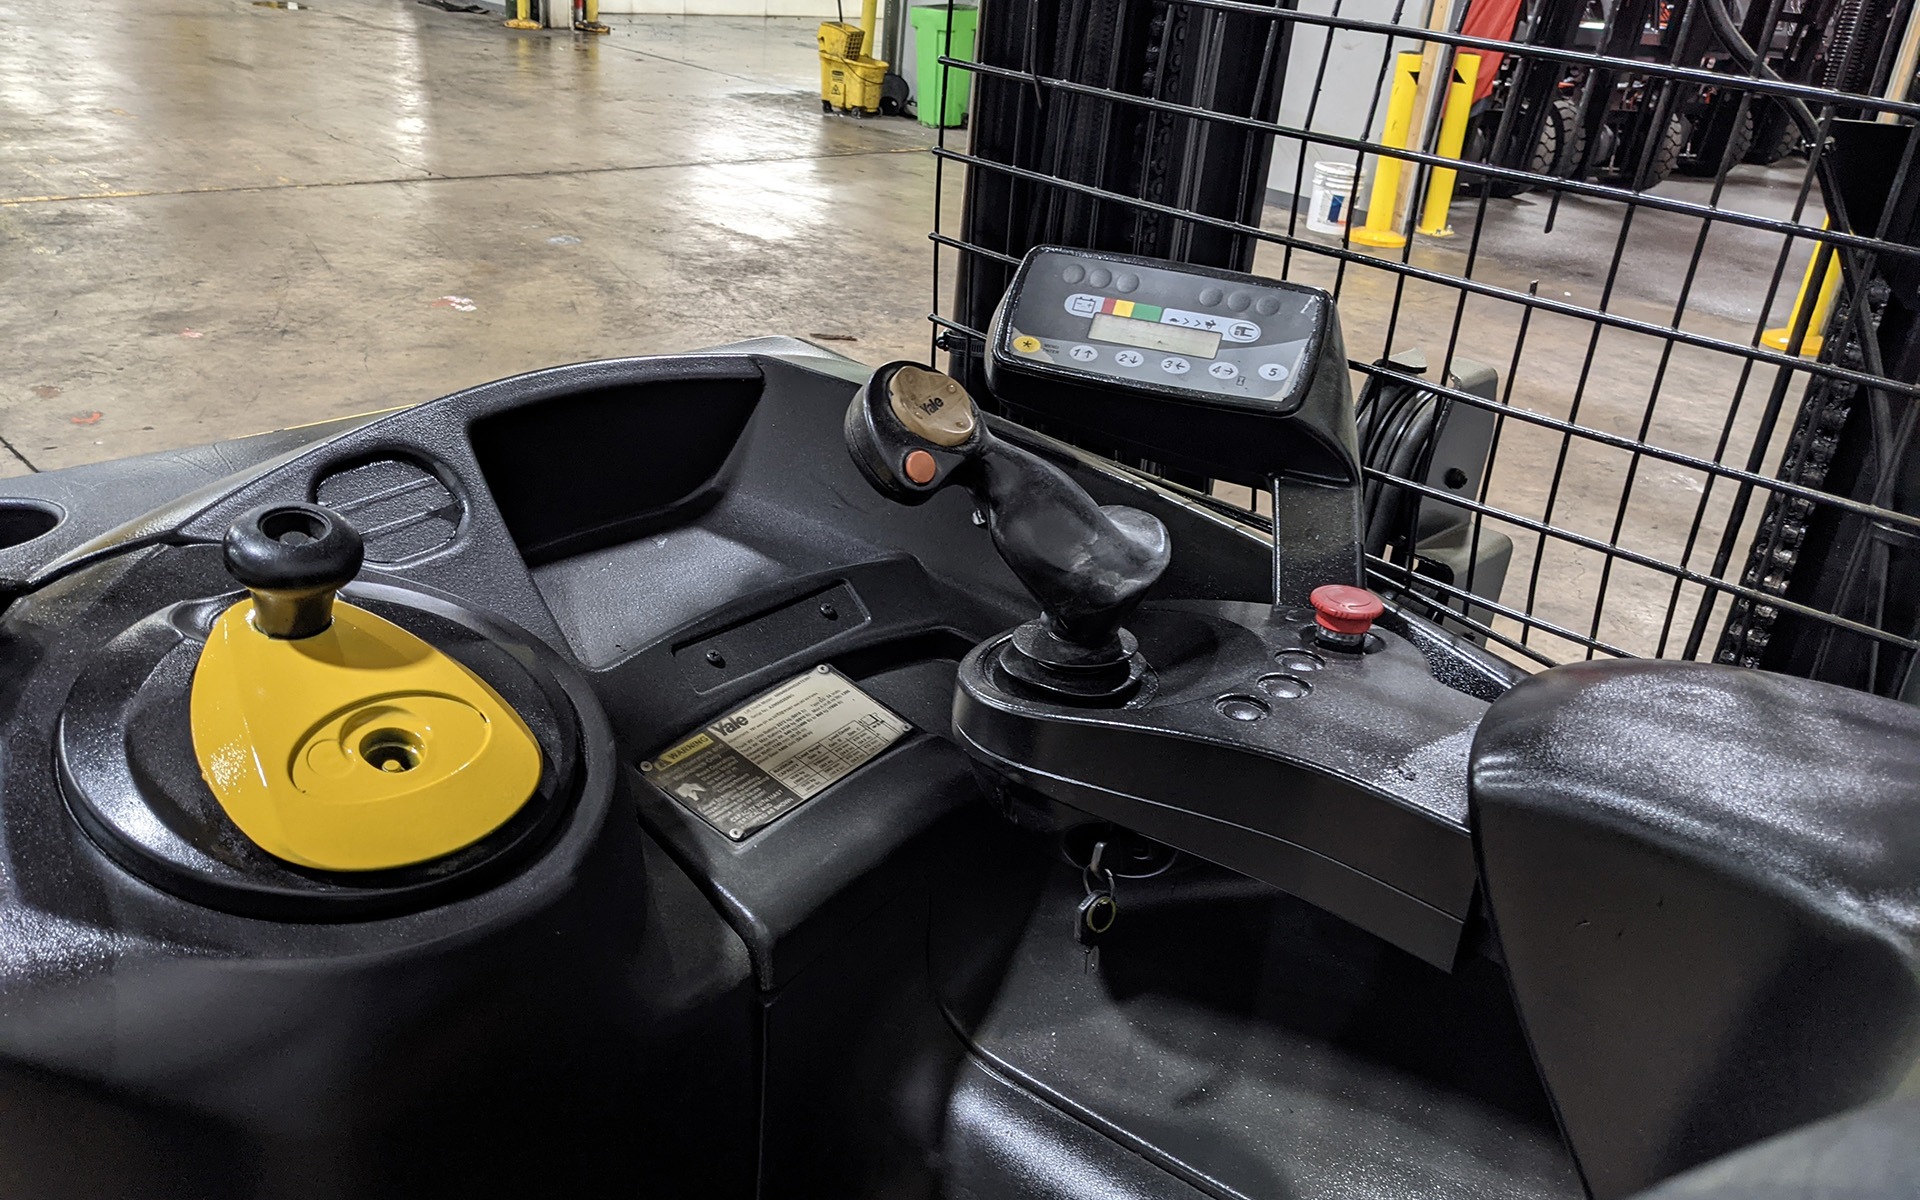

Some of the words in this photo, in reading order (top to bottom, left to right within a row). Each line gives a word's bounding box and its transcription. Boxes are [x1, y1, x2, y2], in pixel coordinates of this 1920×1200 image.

[1268, 368, 1278, 377] 5
[919, 397, 944, 416] Yale
[710, 714, 749, 737] Yale
[667, 735, 710, 760] WARNING
[772, 796, 794, 811] SHOWN
[729, 804, 757, 823] CAPACITY
